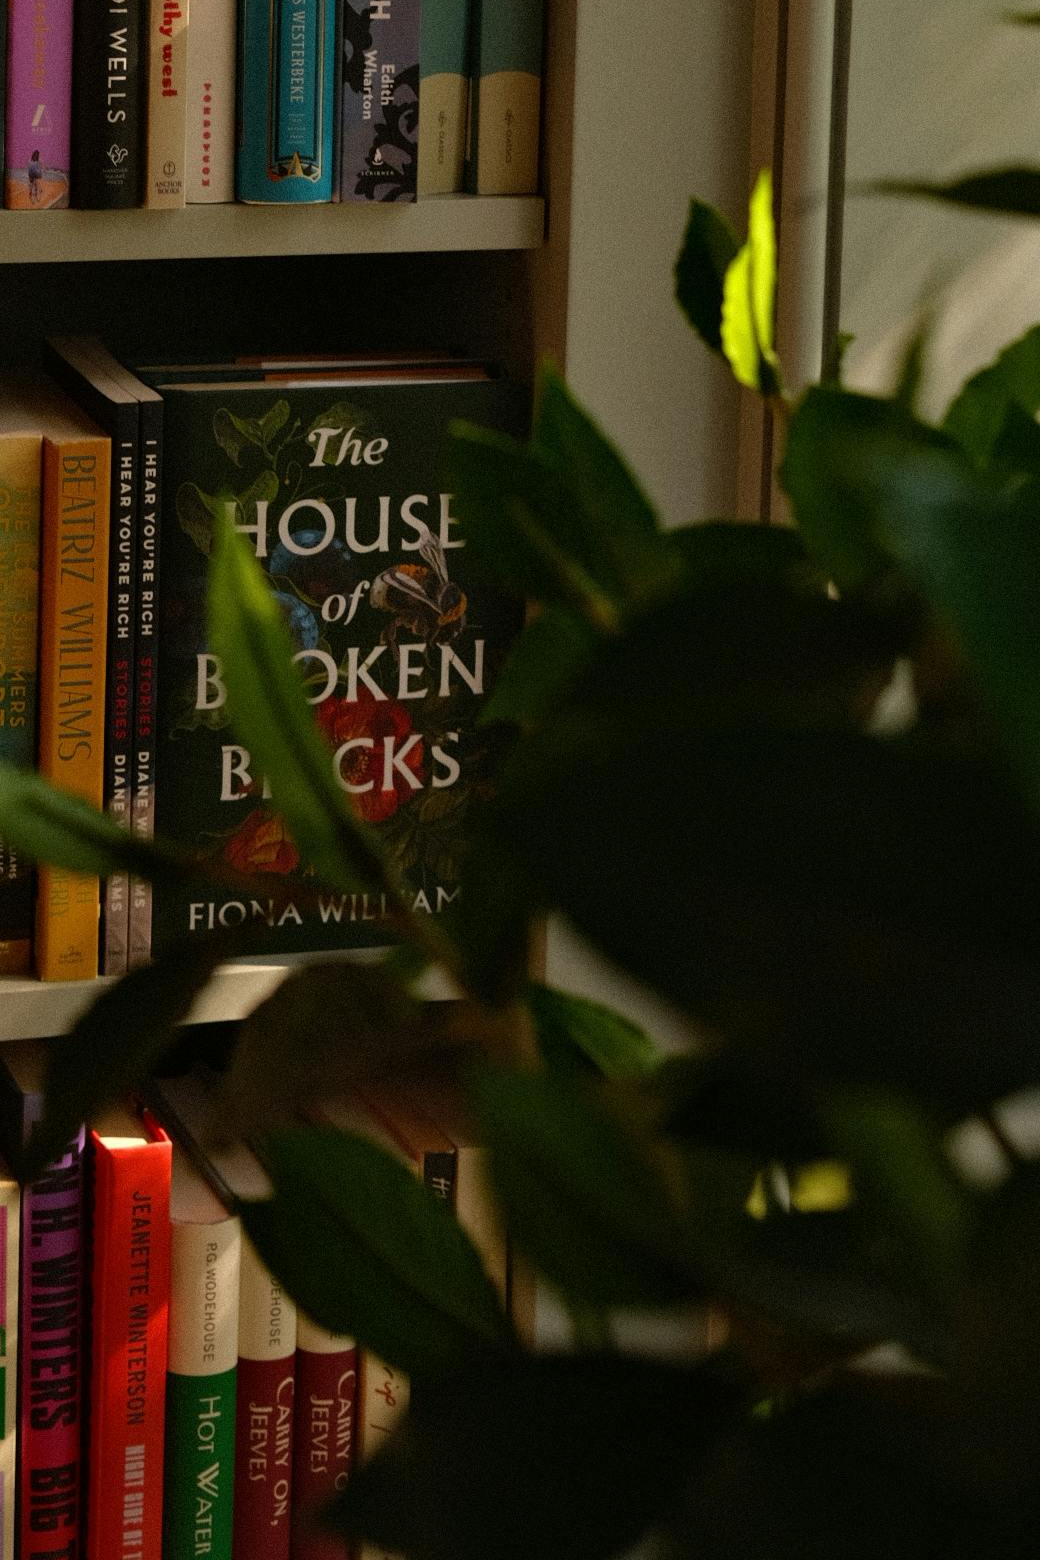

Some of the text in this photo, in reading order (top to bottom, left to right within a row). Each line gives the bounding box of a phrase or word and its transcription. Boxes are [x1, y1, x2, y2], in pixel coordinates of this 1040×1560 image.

[107, 28, 127, 124] WELLS
[290, 11, 307, 103] WESTERBEKE
[361, 49, 379, 120] Wharton
[379, 63, 395, 106] Edith
[143, 454, 156, 505] HEAR
[308, 428, 389, 468] The
[142, 512, 155, 582] YOU'RE
[141, 590, 154, 637] RICH
[321, 580, 364, 625] of
[126, 1191, 151, 1425] JEANETTE WINTERSON
[203, 1267, 217, 1362] WODEHOUSE
